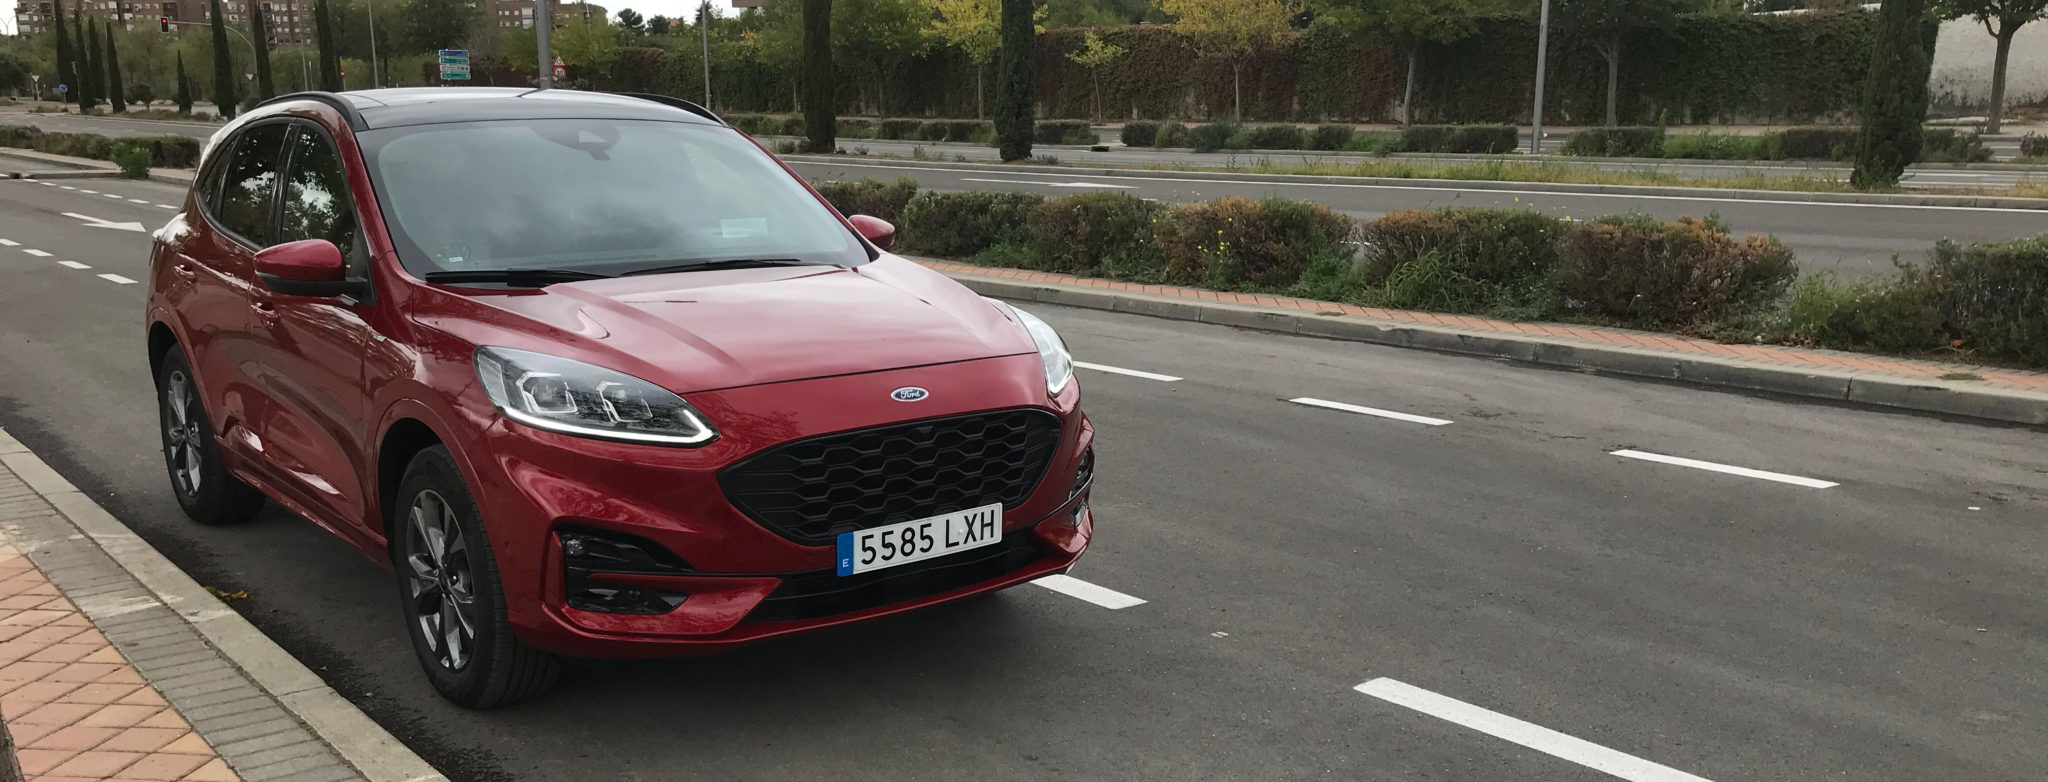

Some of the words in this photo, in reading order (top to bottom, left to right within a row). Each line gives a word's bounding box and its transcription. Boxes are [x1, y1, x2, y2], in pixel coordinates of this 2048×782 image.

[900, 388, 921, 399] Ford
[842, 558, 850, 568] E
[860, 523, 934, 565] 5585
[946, 509, 995, 548] LXH
